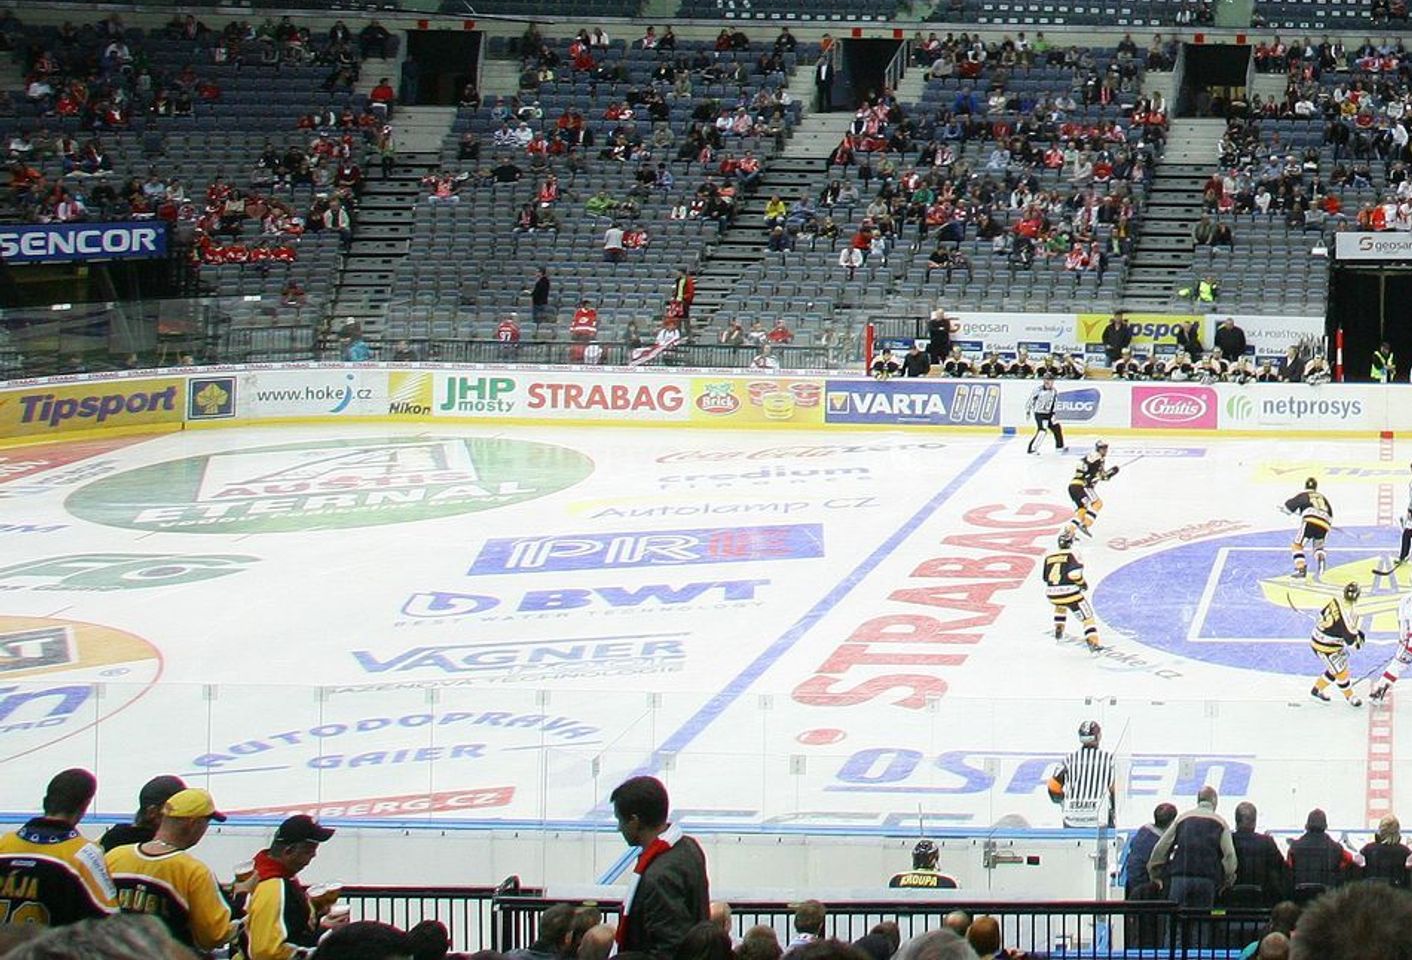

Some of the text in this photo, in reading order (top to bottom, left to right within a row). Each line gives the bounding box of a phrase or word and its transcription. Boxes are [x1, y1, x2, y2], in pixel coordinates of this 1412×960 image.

[0, 227, 157, 257] SENCOR
[963, 321, 1009, 335] geosan
[20, 386, 176, 427] Tipsport
[257, 374, 373, 414] www.hokej.cz
[440, 376, 516, 411] JHP
[458, 399, 516, 413] mosty
[527, 383, 684, 412] STRABAG
[702, 395, 735, 410] Brick
[851, 393, 947, 415] VARTA
[1056, 400, 1094, 413] ERLOG
[1262, 396, 1361, 419] netprosys
[388, 402, 432, 415] Nikon
[133, 480, 535, 524] ETERNAL
[591, 496, 881, 520] Autolamp CZ
[1049, 562, 1063, 585] 4
[516, 580, 772, 612] BWT
[790, 501, 1078, 711] STRABAG
[191, 711, 602, 768] AUTODOPRAVA
[306, 743, 488, 770] GAIER
[0, 871, 38, 900] ÁJA
